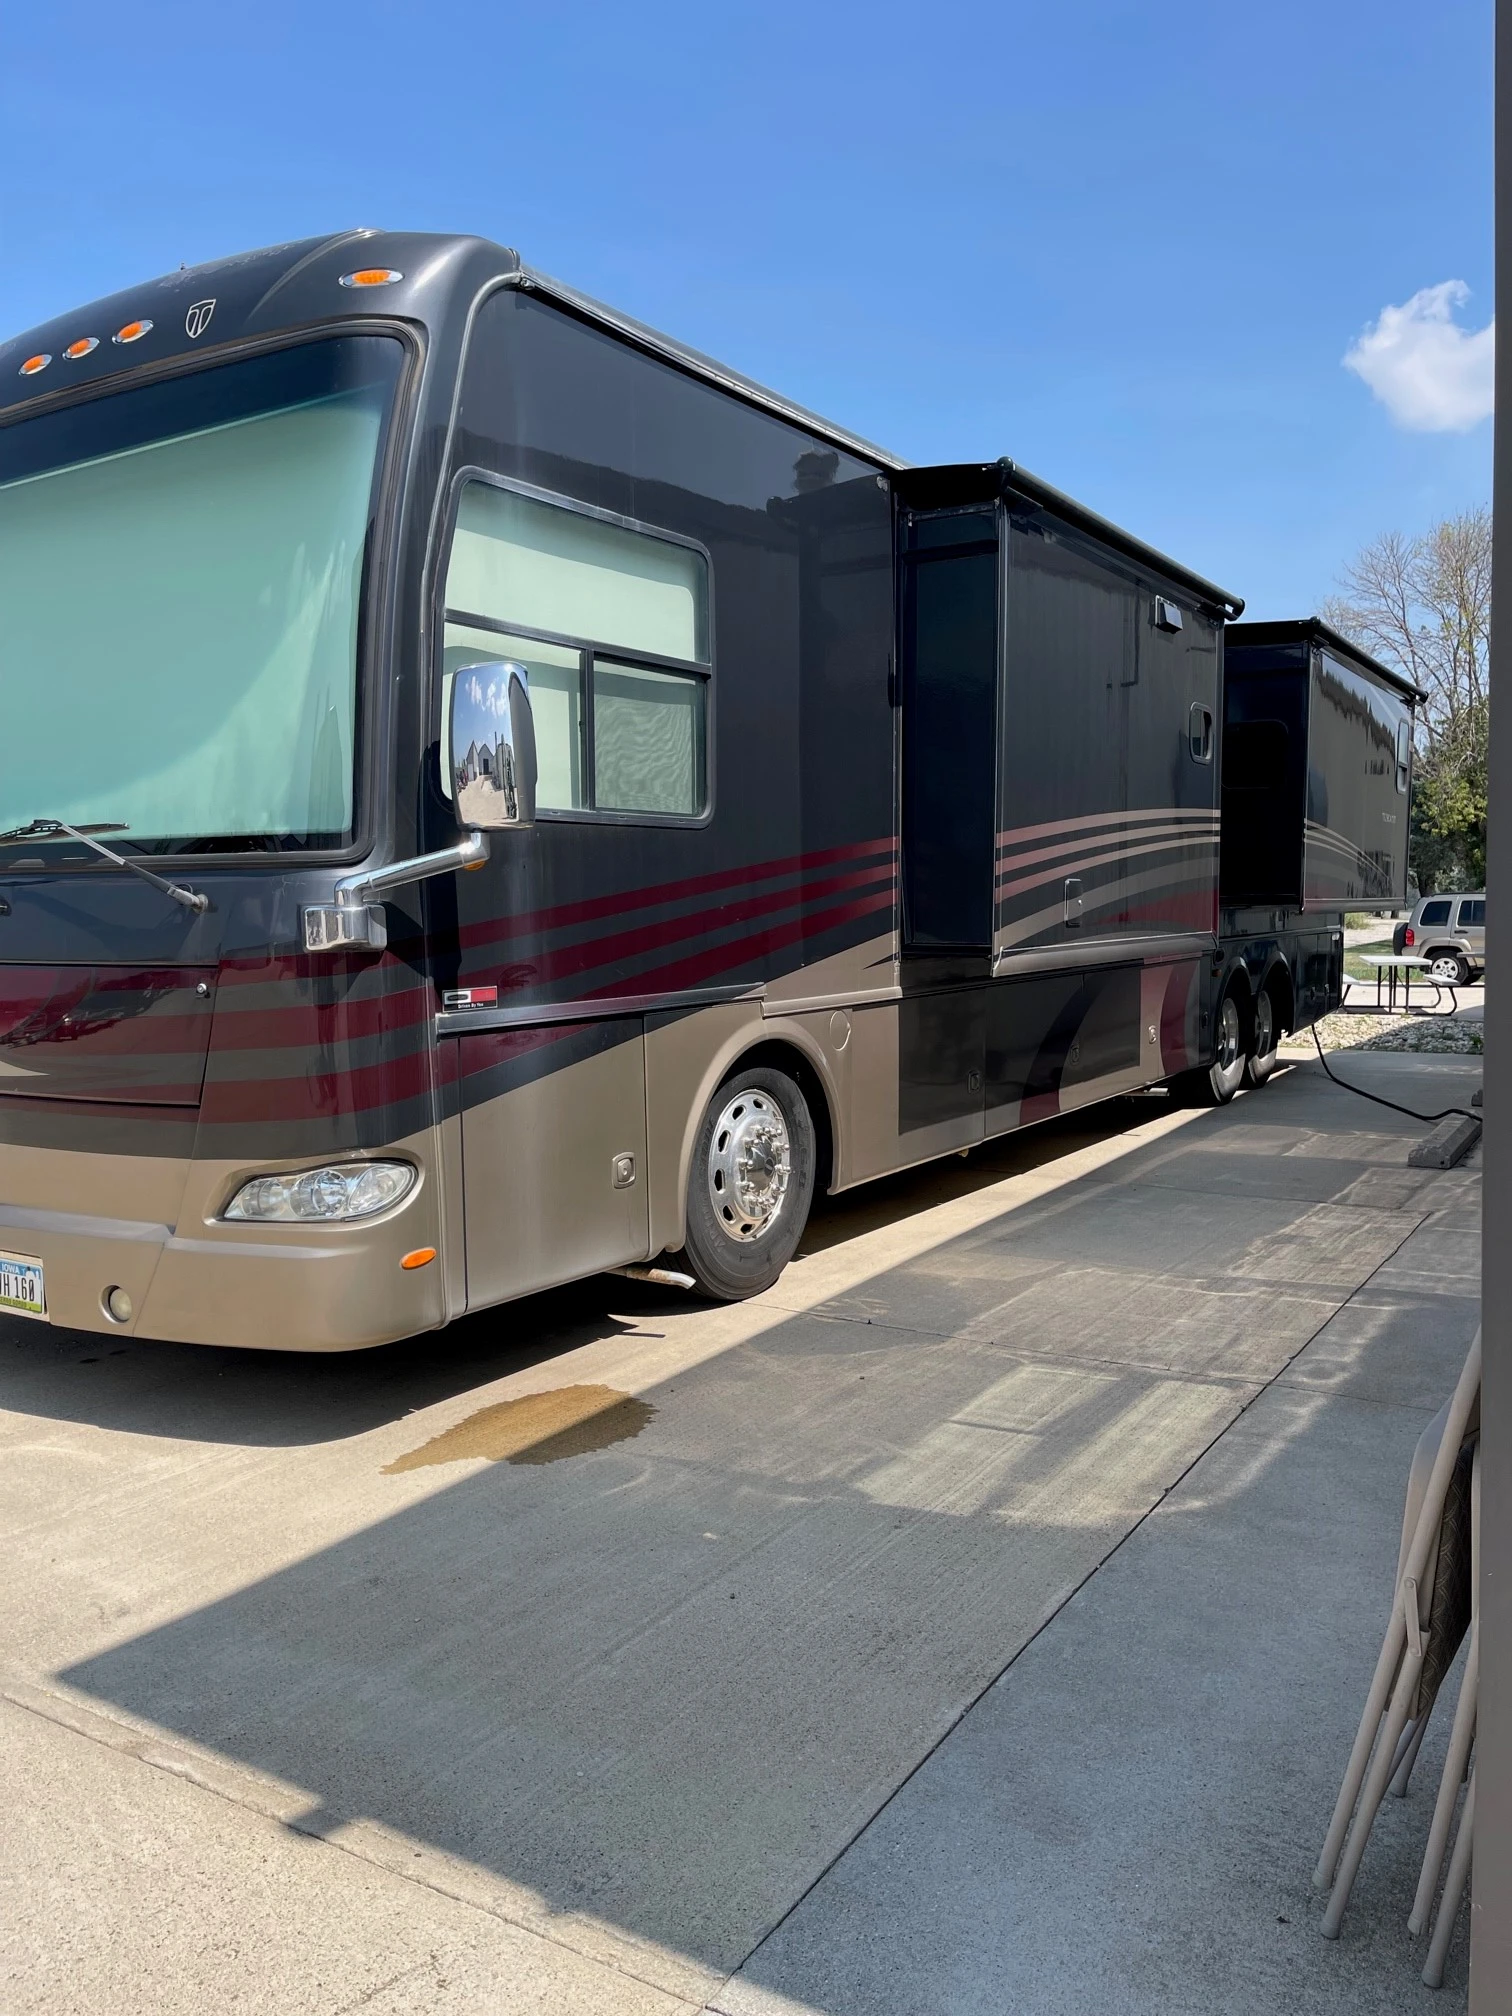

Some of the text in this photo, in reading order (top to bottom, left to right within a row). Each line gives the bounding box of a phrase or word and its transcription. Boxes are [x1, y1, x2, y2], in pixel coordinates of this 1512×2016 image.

[2, 1264, 20, 1274] IOWA
[0, 1272, 34, 1302] H 160
